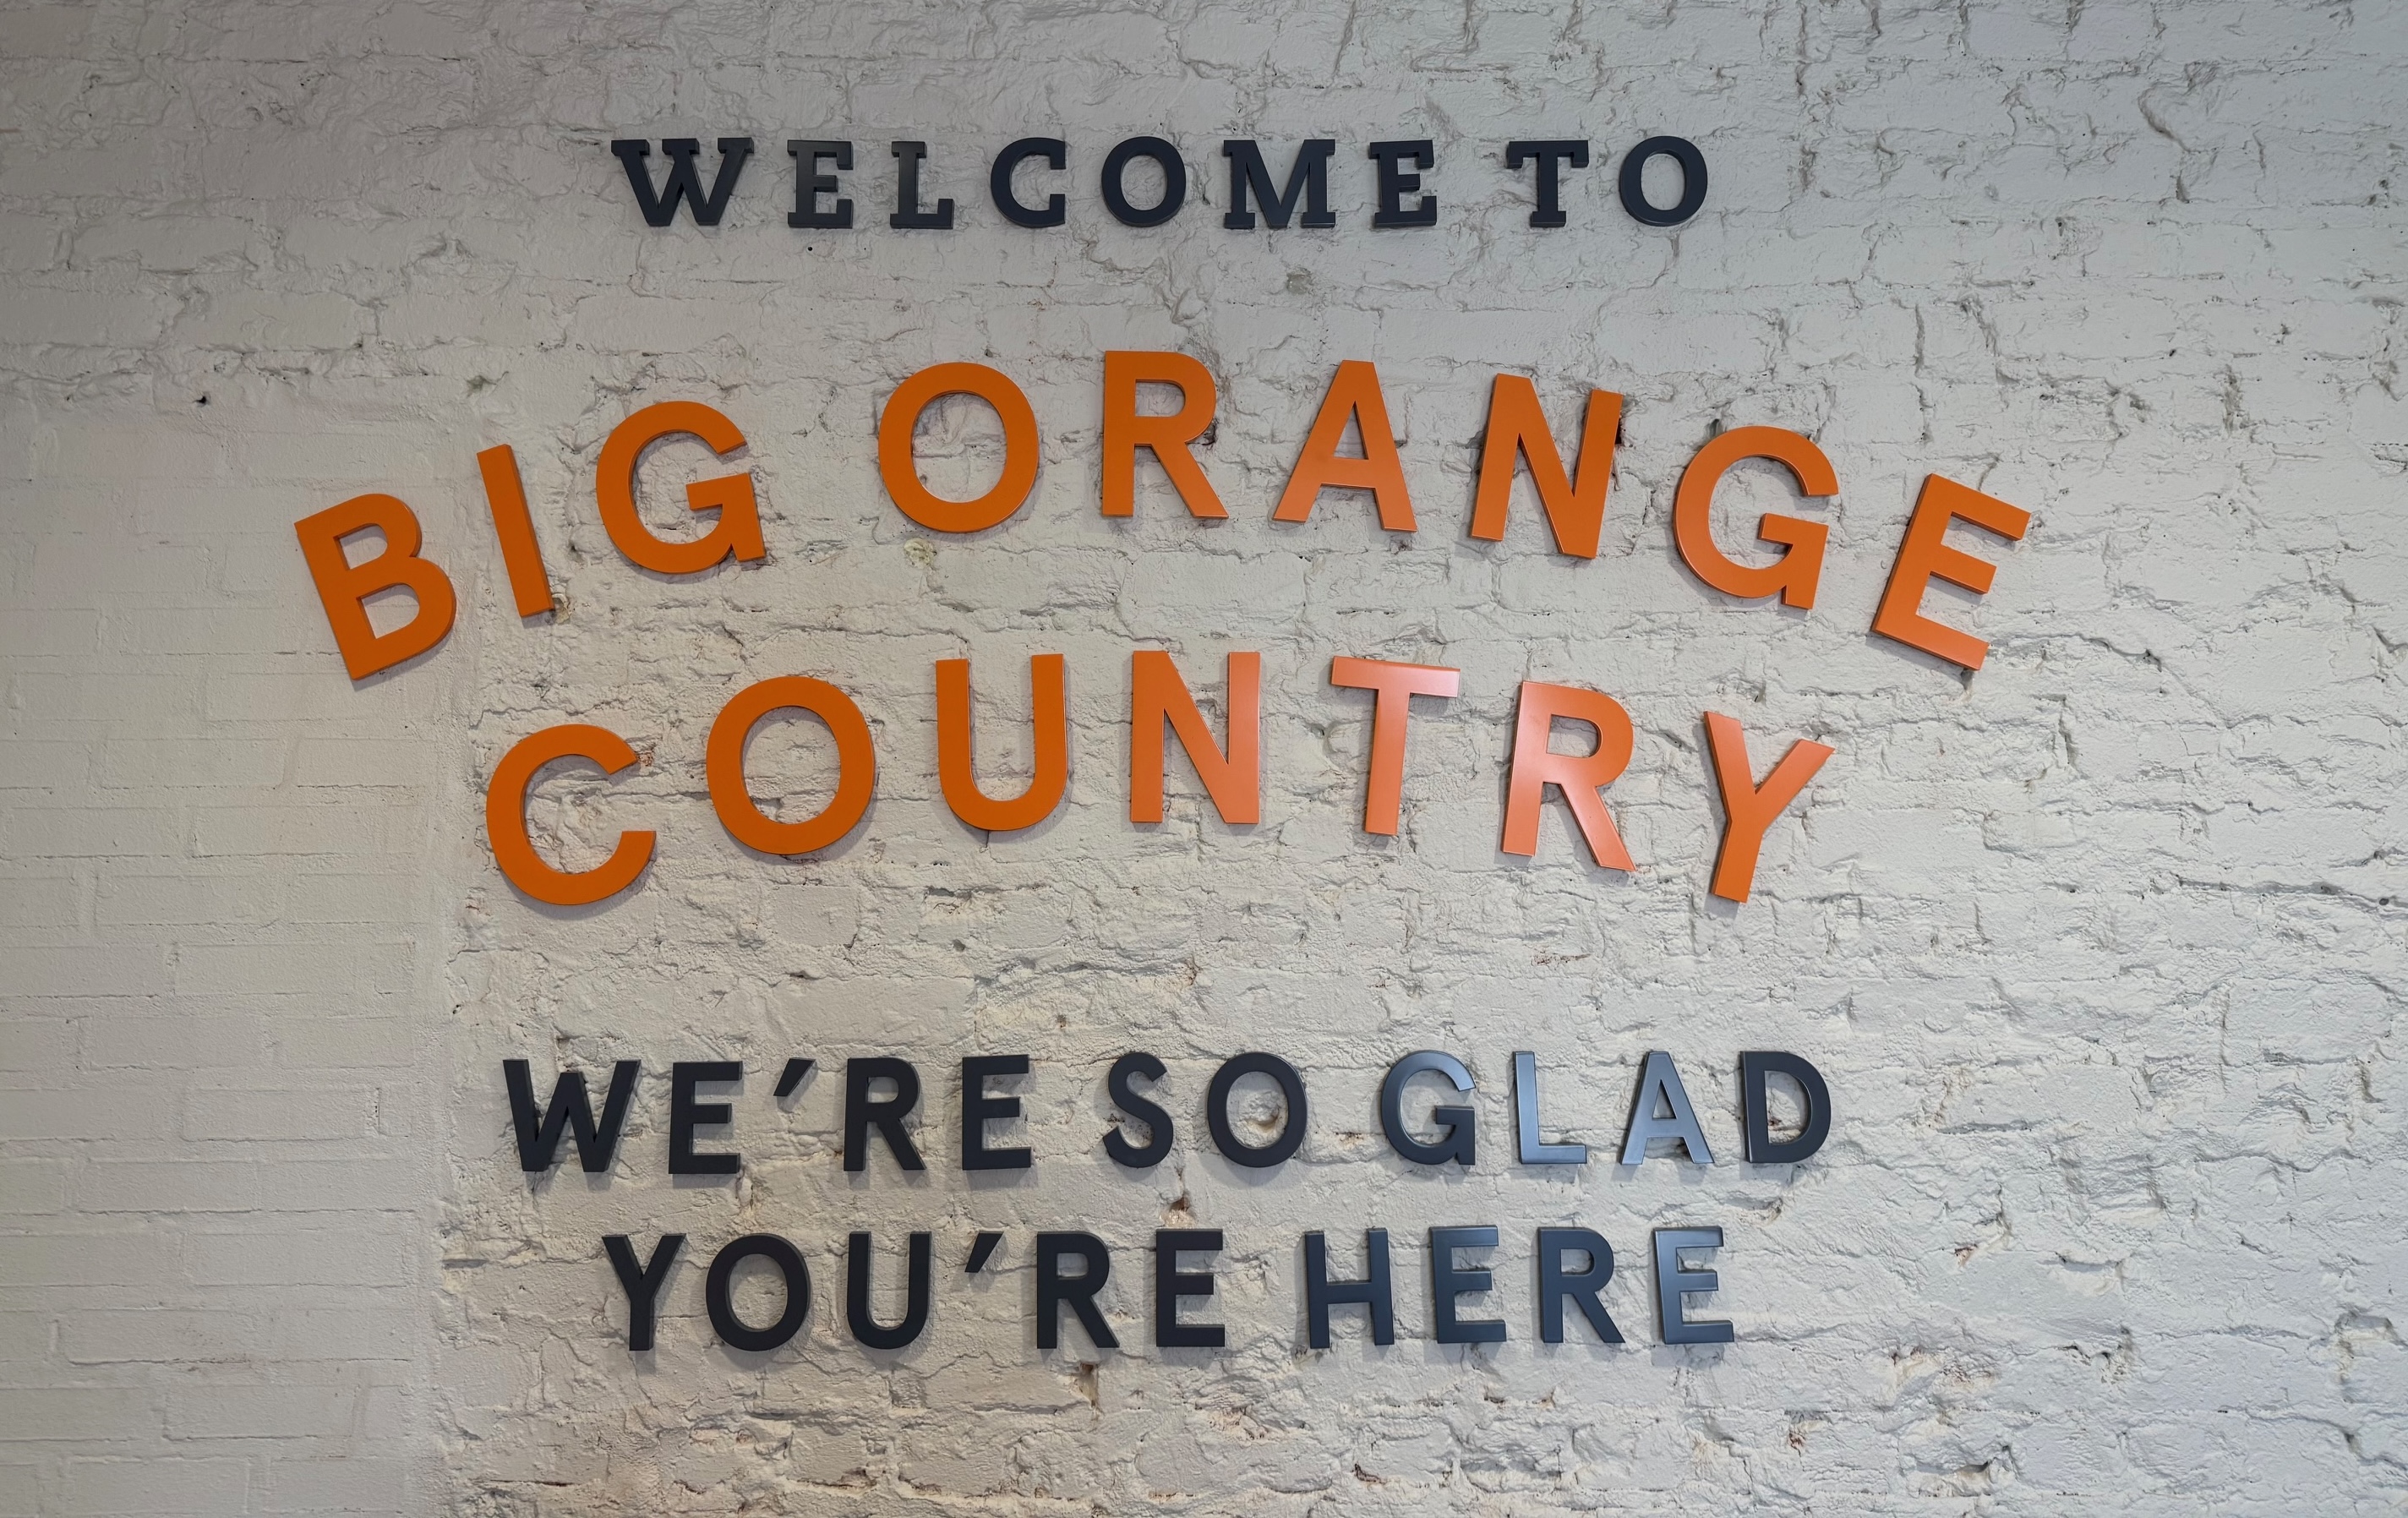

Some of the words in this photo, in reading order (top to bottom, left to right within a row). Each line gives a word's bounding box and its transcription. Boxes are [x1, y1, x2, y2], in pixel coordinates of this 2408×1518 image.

[611, 136, 1438, 231] WELCOME
[1504, 136, 1708, 229] TO
[294, 400, 766, 680] BIG
[877, 350, 2032, 671] ORANGE
[485, 650, 1835, 905] COUNTRY
[503, 1055, 1033, 1182] WE'RE
[1102, 1051, 1308, 1168] SO
[1379, 1050, 1832, 1166] GLAD
[601, 1228, 1226, 1359] YOU'RE
[1302, 1225, 1735, 1350] HERE
